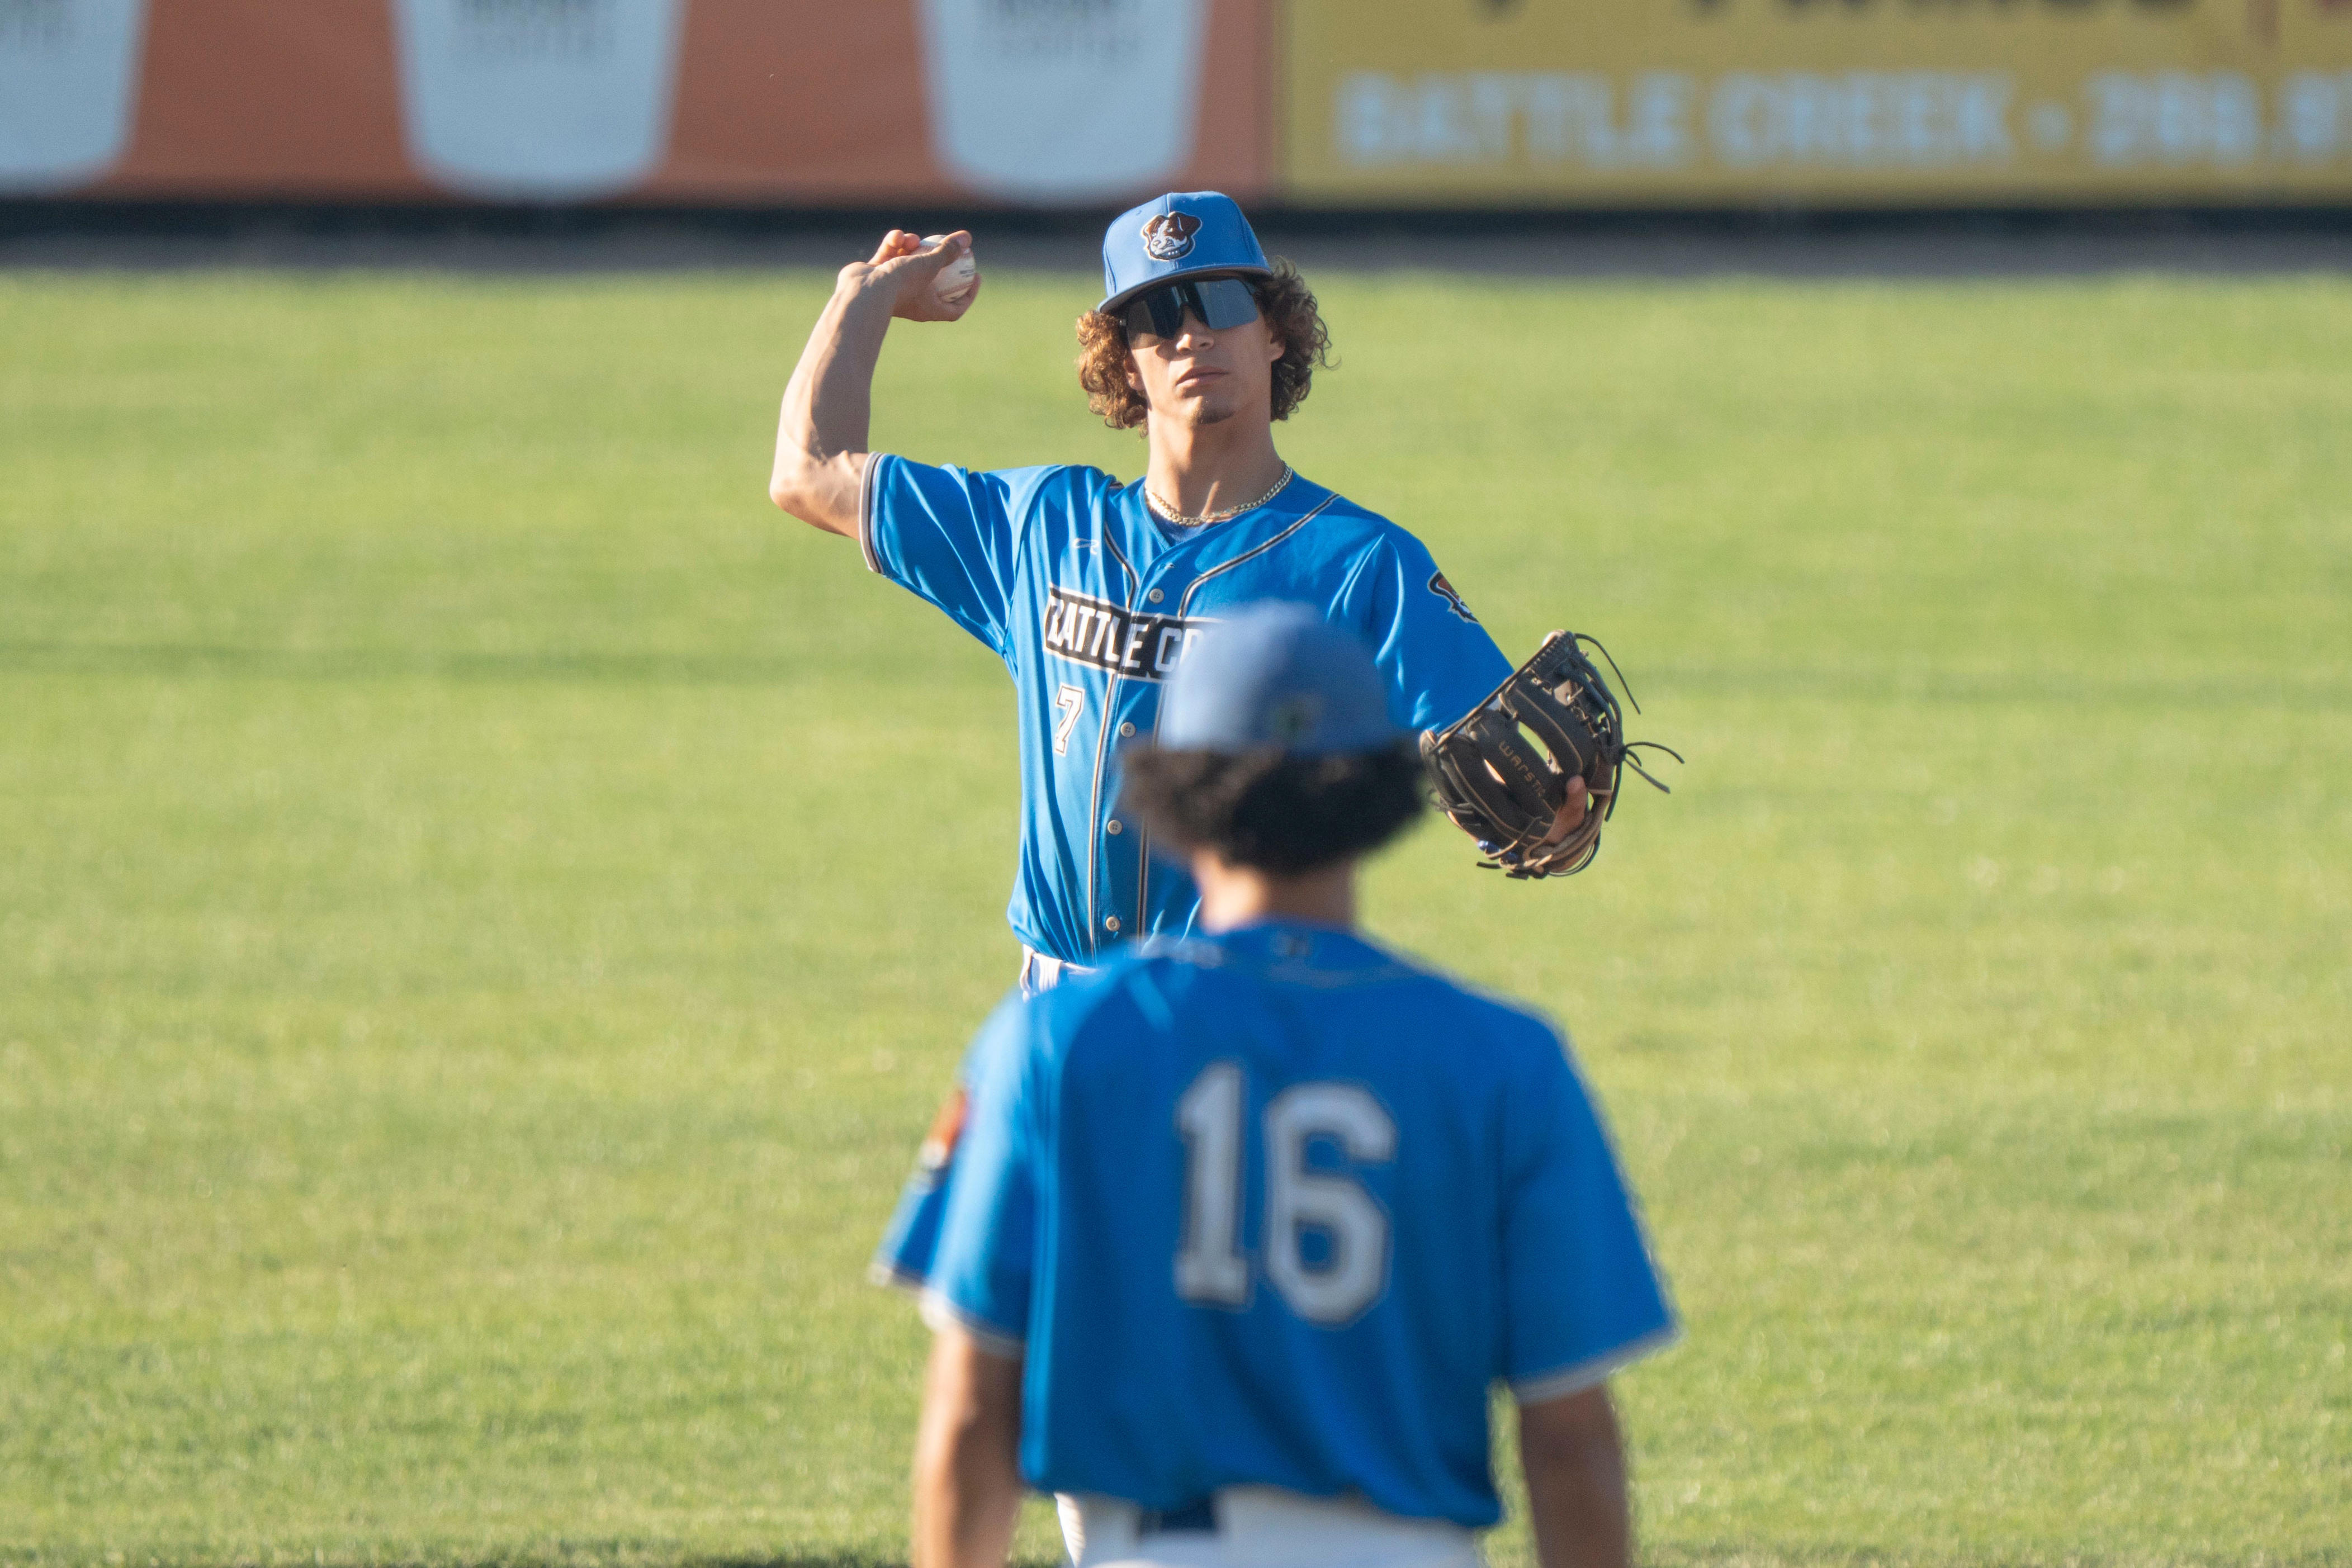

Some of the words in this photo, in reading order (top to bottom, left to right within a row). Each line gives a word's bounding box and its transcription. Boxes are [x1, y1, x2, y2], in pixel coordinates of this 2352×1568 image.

[1336, 70, 1697, 169] BATTLE
[1708, 68, 2015, 168] CREEK
[1054, 682, 1086, 757] 7
[1173, 1058, 1399, 1329] 16
